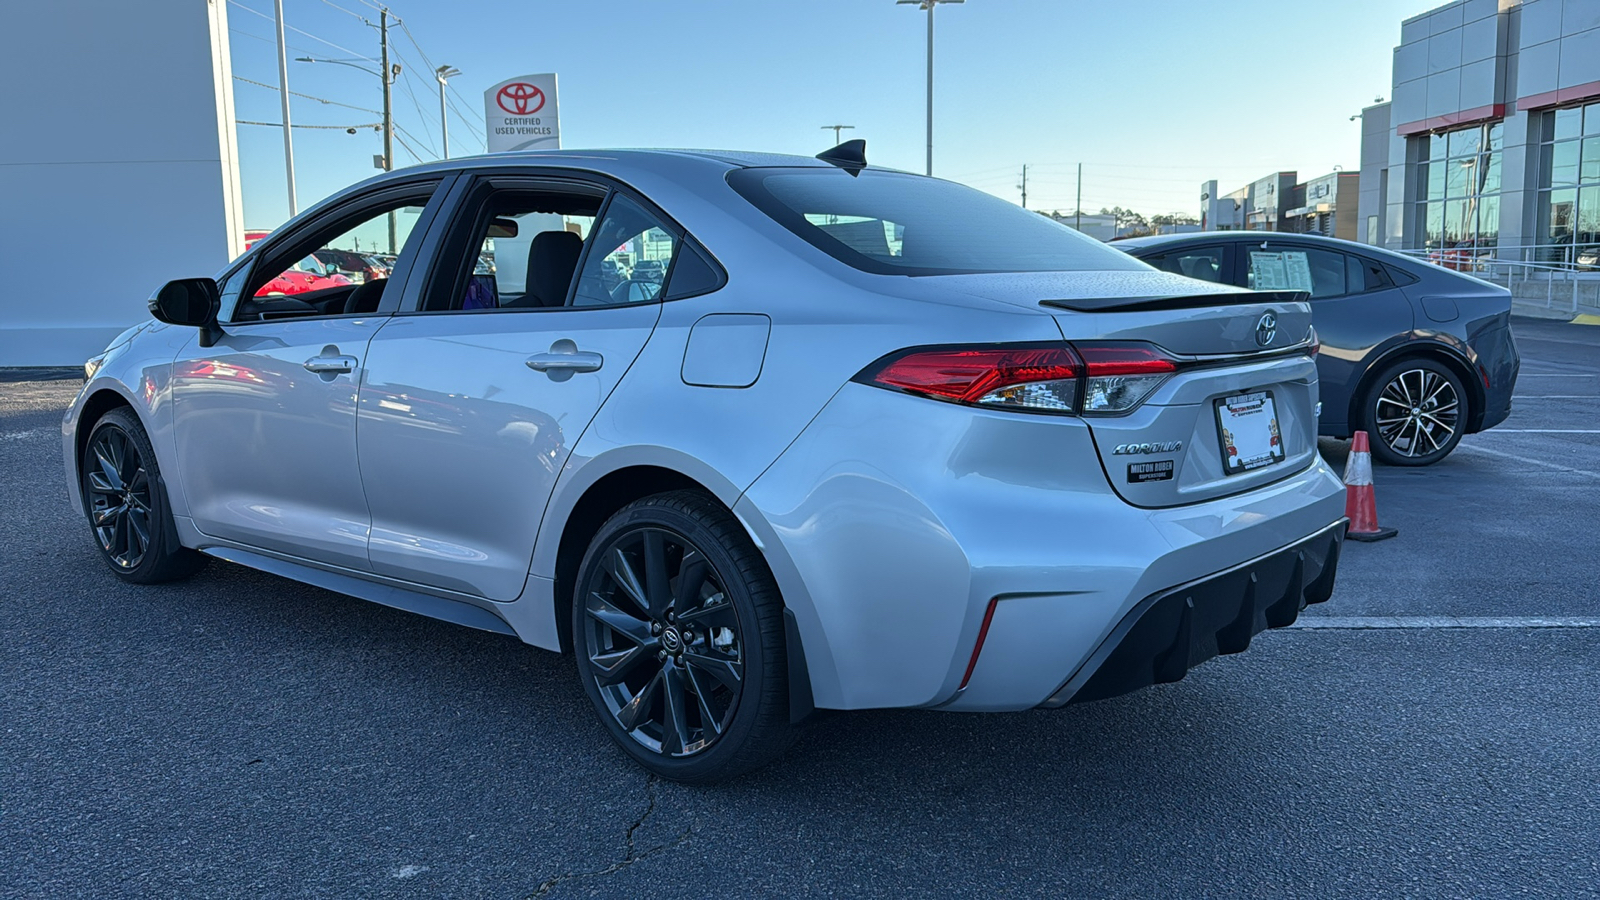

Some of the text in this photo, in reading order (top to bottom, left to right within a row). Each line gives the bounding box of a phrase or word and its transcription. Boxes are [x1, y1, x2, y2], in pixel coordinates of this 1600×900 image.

[495, 127, 551, 135] USED VEHICLES
[1112, 440, 1182, 455] COROLLA
[1130, 461, 1173, 474] MILTON RUBEN
[1138, 472, 1167, 480] SUPERSTORE
